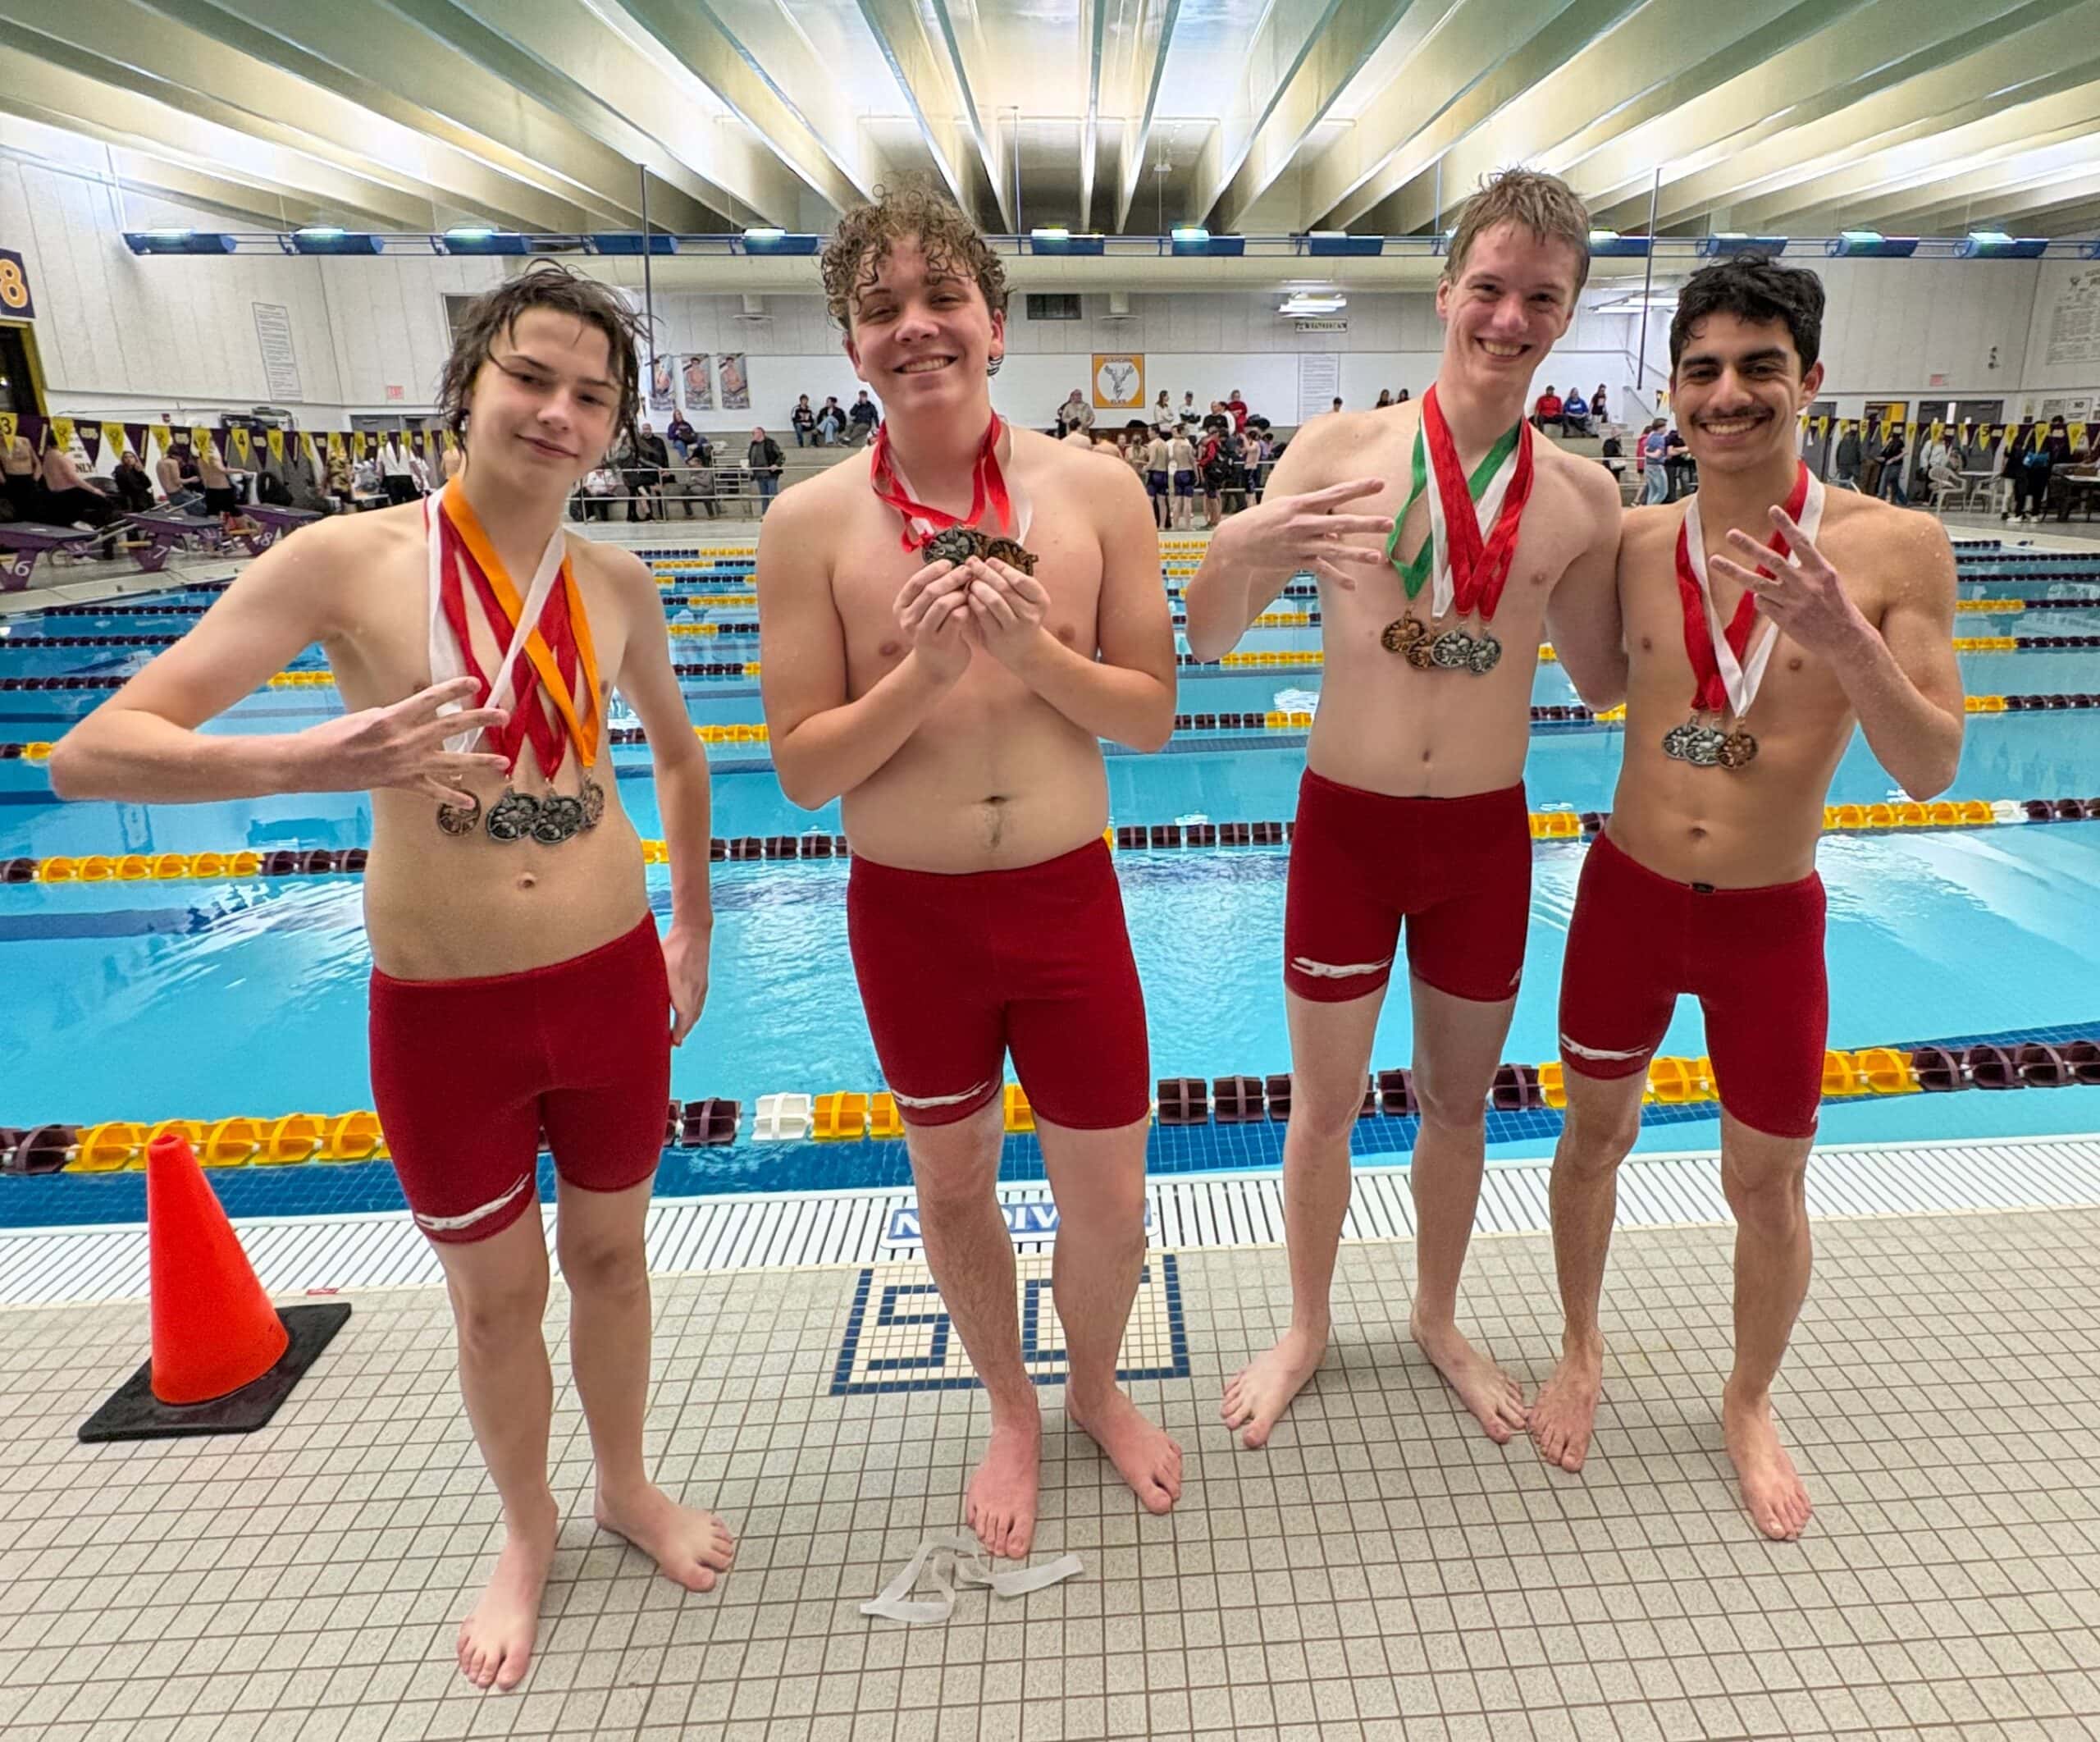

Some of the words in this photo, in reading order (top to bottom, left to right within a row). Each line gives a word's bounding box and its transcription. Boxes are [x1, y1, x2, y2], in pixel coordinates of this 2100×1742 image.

[0, 258, 27, 309] 8
[0, 417, 11, 435] 3
[238, 432, 245, 446] 4
[75, 463, 93, 473] NLY
[261, 532, 273, 546] 8
[153, 544, 168, 559] 7
[15, 560, 32, 576] 6
